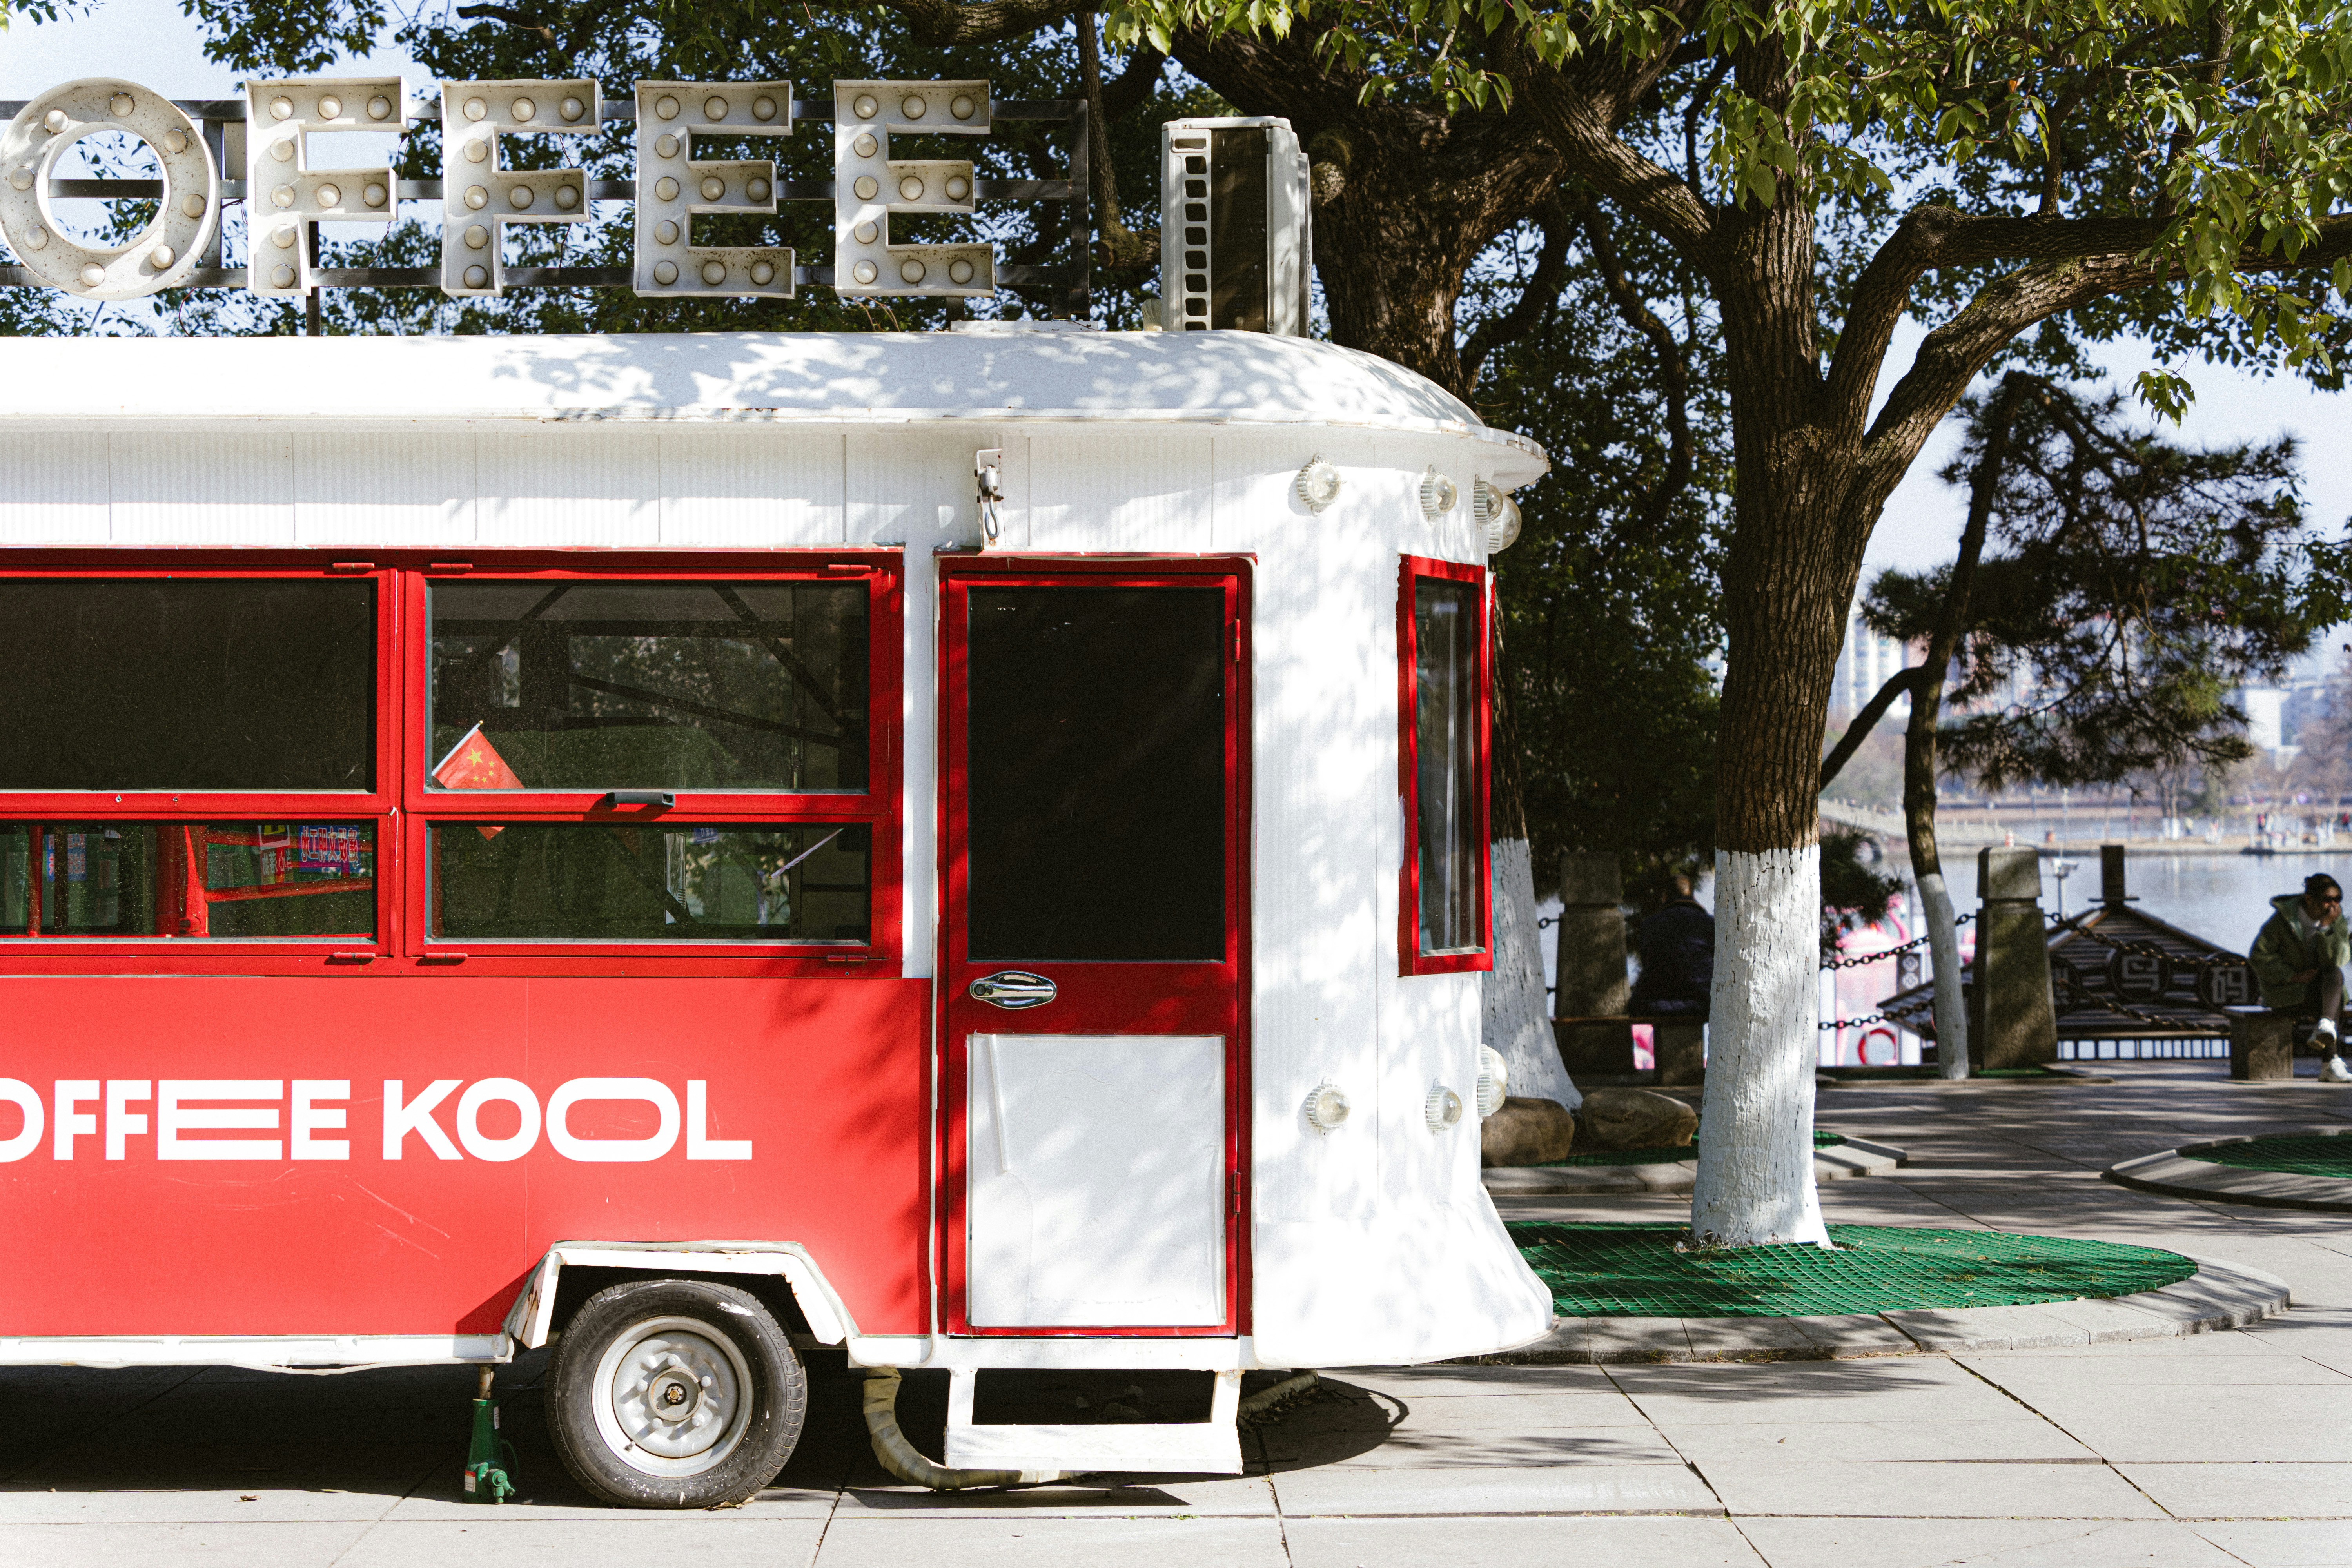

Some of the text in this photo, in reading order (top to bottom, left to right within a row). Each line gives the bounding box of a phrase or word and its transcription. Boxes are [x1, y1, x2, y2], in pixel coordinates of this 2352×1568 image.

[0, 77, 995, 300] OFFEE
[383, 1077, 752, 1162] KOOL
[577, 1289, 699, 1354] MILES SPEED
